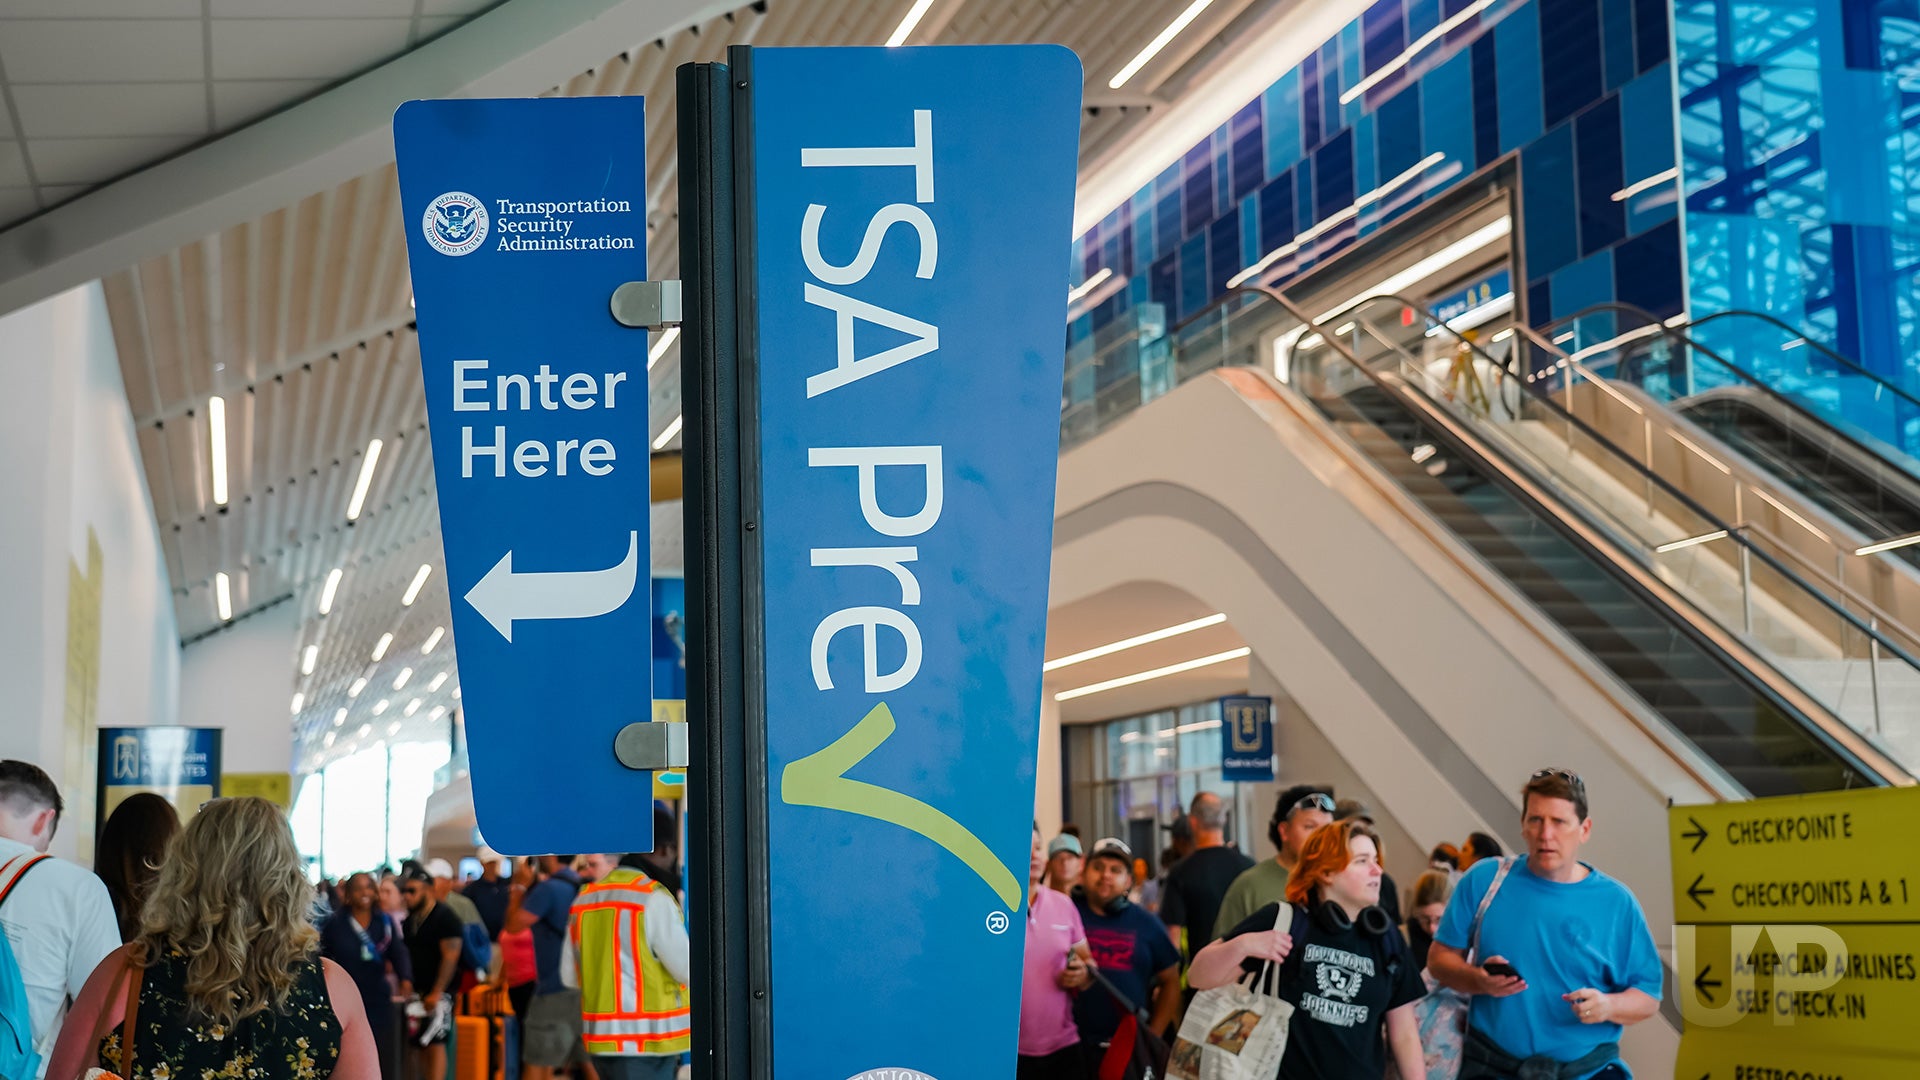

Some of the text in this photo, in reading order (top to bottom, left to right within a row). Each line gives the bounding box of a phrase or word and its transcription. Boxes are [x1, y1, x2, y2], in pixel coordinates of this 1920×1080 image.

[436, 195, 481, 211] DEPARTMENT
[496, 198, 631, 218] Transportation
[427, 226, 486, 253] HOMELAND SECURITY
[497, 218, 574, 236] Security
[496, 235, 635, 252] Administration
[453, 359, 627, 412] Enter
[801, 109, 943, 693] TSA Pre
[461, 425, 617, 478] Here
[1726, 814, 1853, 845] CHECKPOINT E
[1731, 879, 1909, 907] CHECKPOINTS A & 1
[1304, 943, 1376, 977] DOWNTOWN
[1734, 953, 1917, 981] AMERICAN AIRLINES
[1735, 989, 1867, 1020] SELF CHECK-IN
